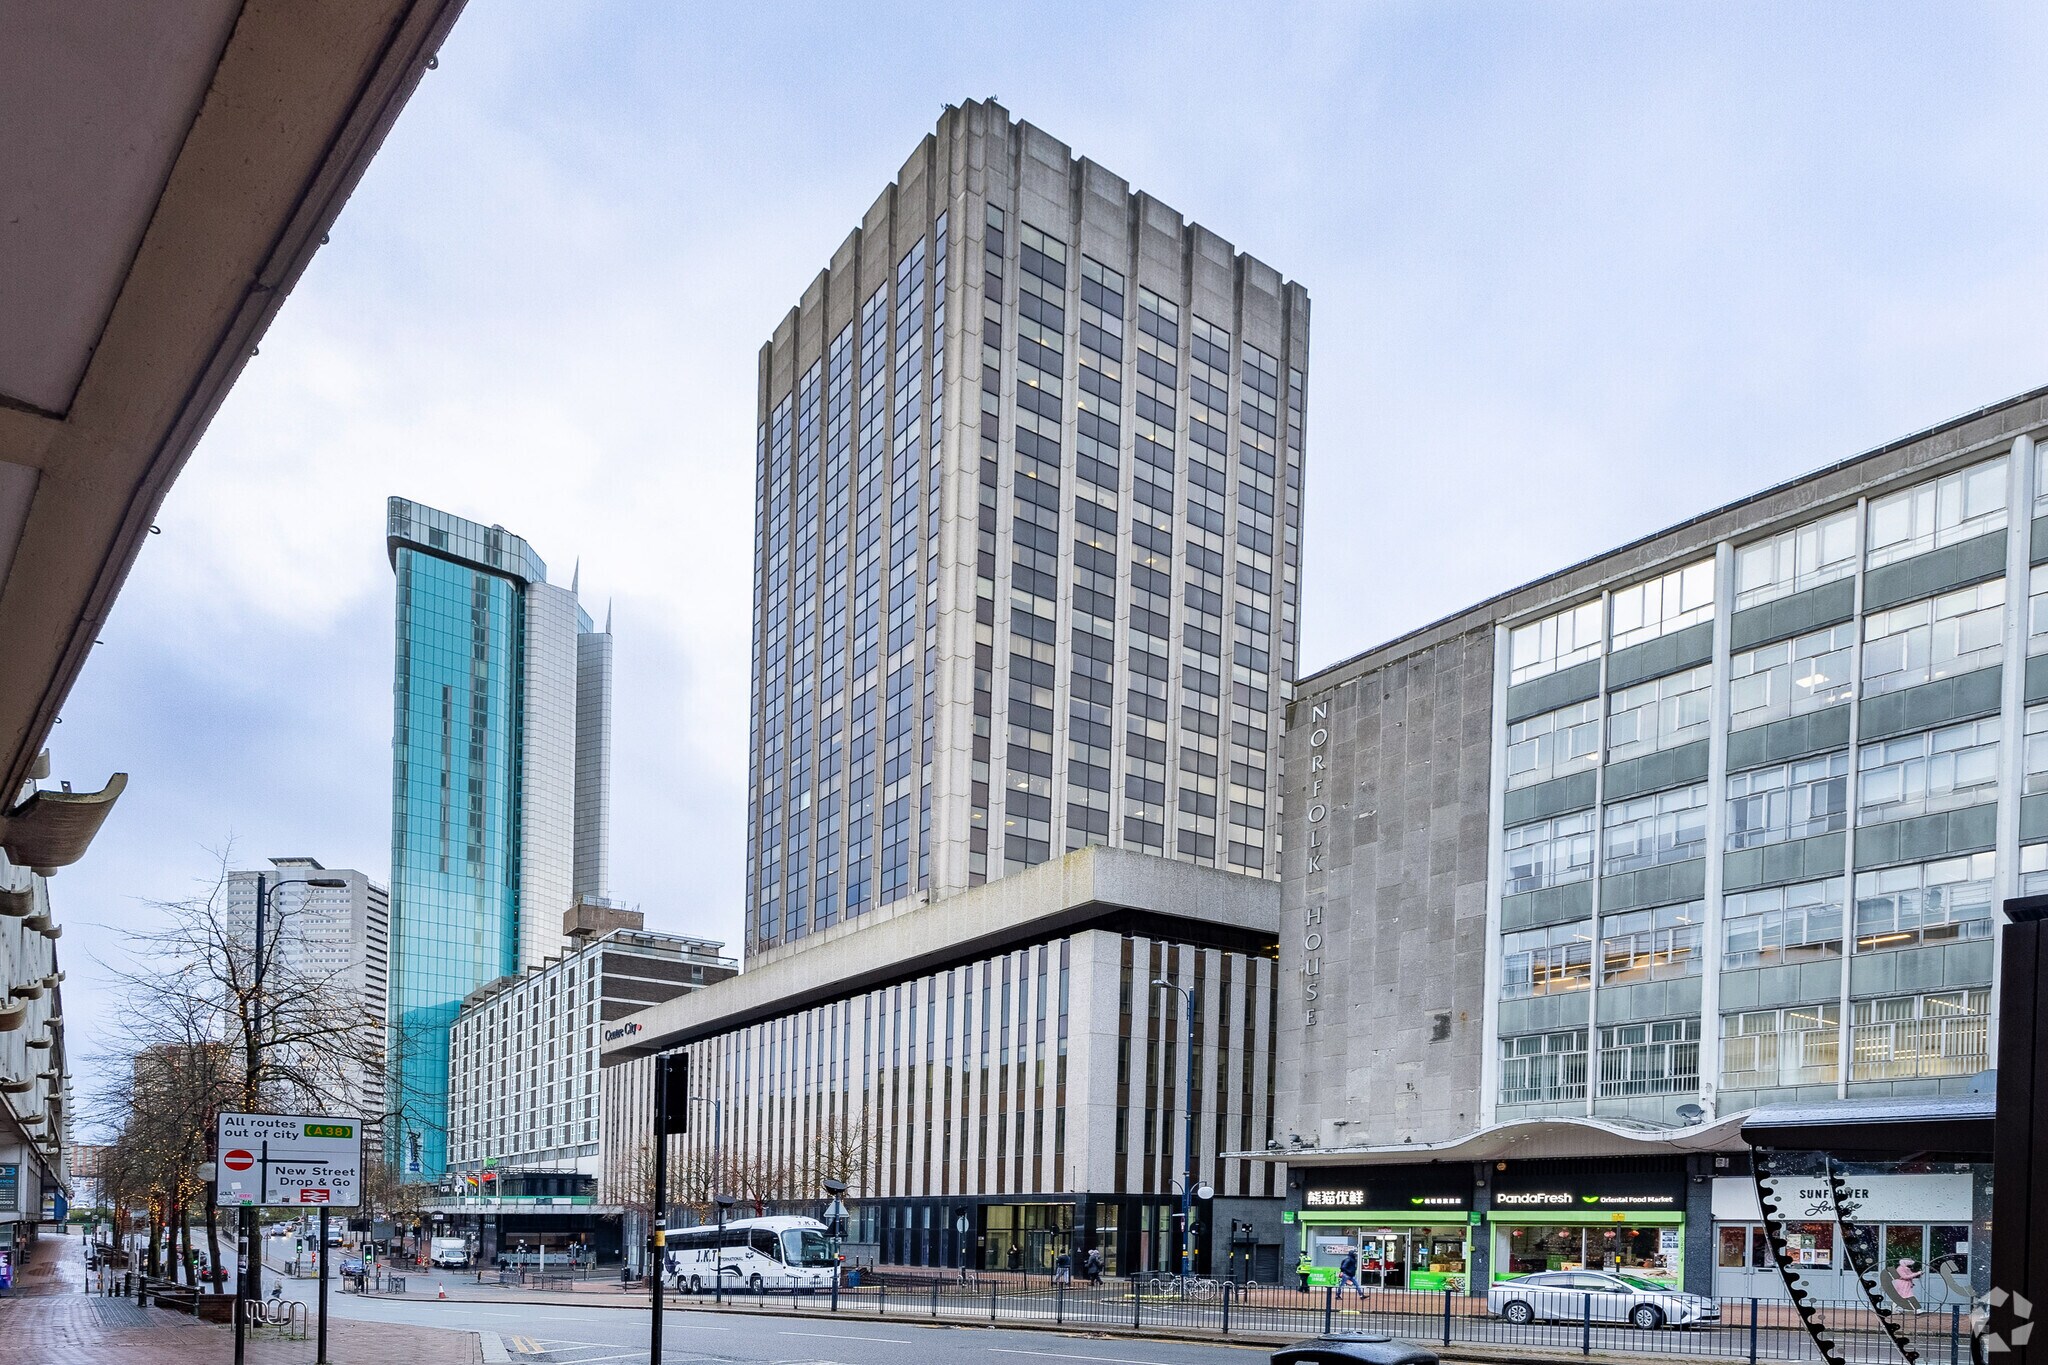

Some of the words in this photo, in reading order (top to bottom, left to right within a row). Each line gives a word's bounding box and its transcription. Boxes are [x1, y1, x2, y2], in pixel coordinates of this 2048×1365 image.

[1308, 701, 1329, 874] NORFOLK
[1304, 906, 1322, 1026] HOUSE
[605, 1028, 624, 1041] Centre
[624, 1022, 637, 1035] City
[224, 1117, 245, 1126] All
[250, 1119, 297, 1129] routes
[224, 1129, 249, 1137] out
[254, 1129, 269, 1138] of
[273, 1130, 300, 1140] city
[275, 1166, 307, 1175] New
[312, 1166, 356, 1176] Street
[280, 1178, 313, 1187] Drop
[318, 1178, 327, 1186] &
[332, 1178, 351, 1187] Go
[1307, 1190, 1364, 1205] 熊猫优鲜
[1497, 1192, 1573, 1204] PandaFresh
[1799, 1188, 1869, 1199] SUNFOWER
[696, 1250, 717, 1262] J.K.T
